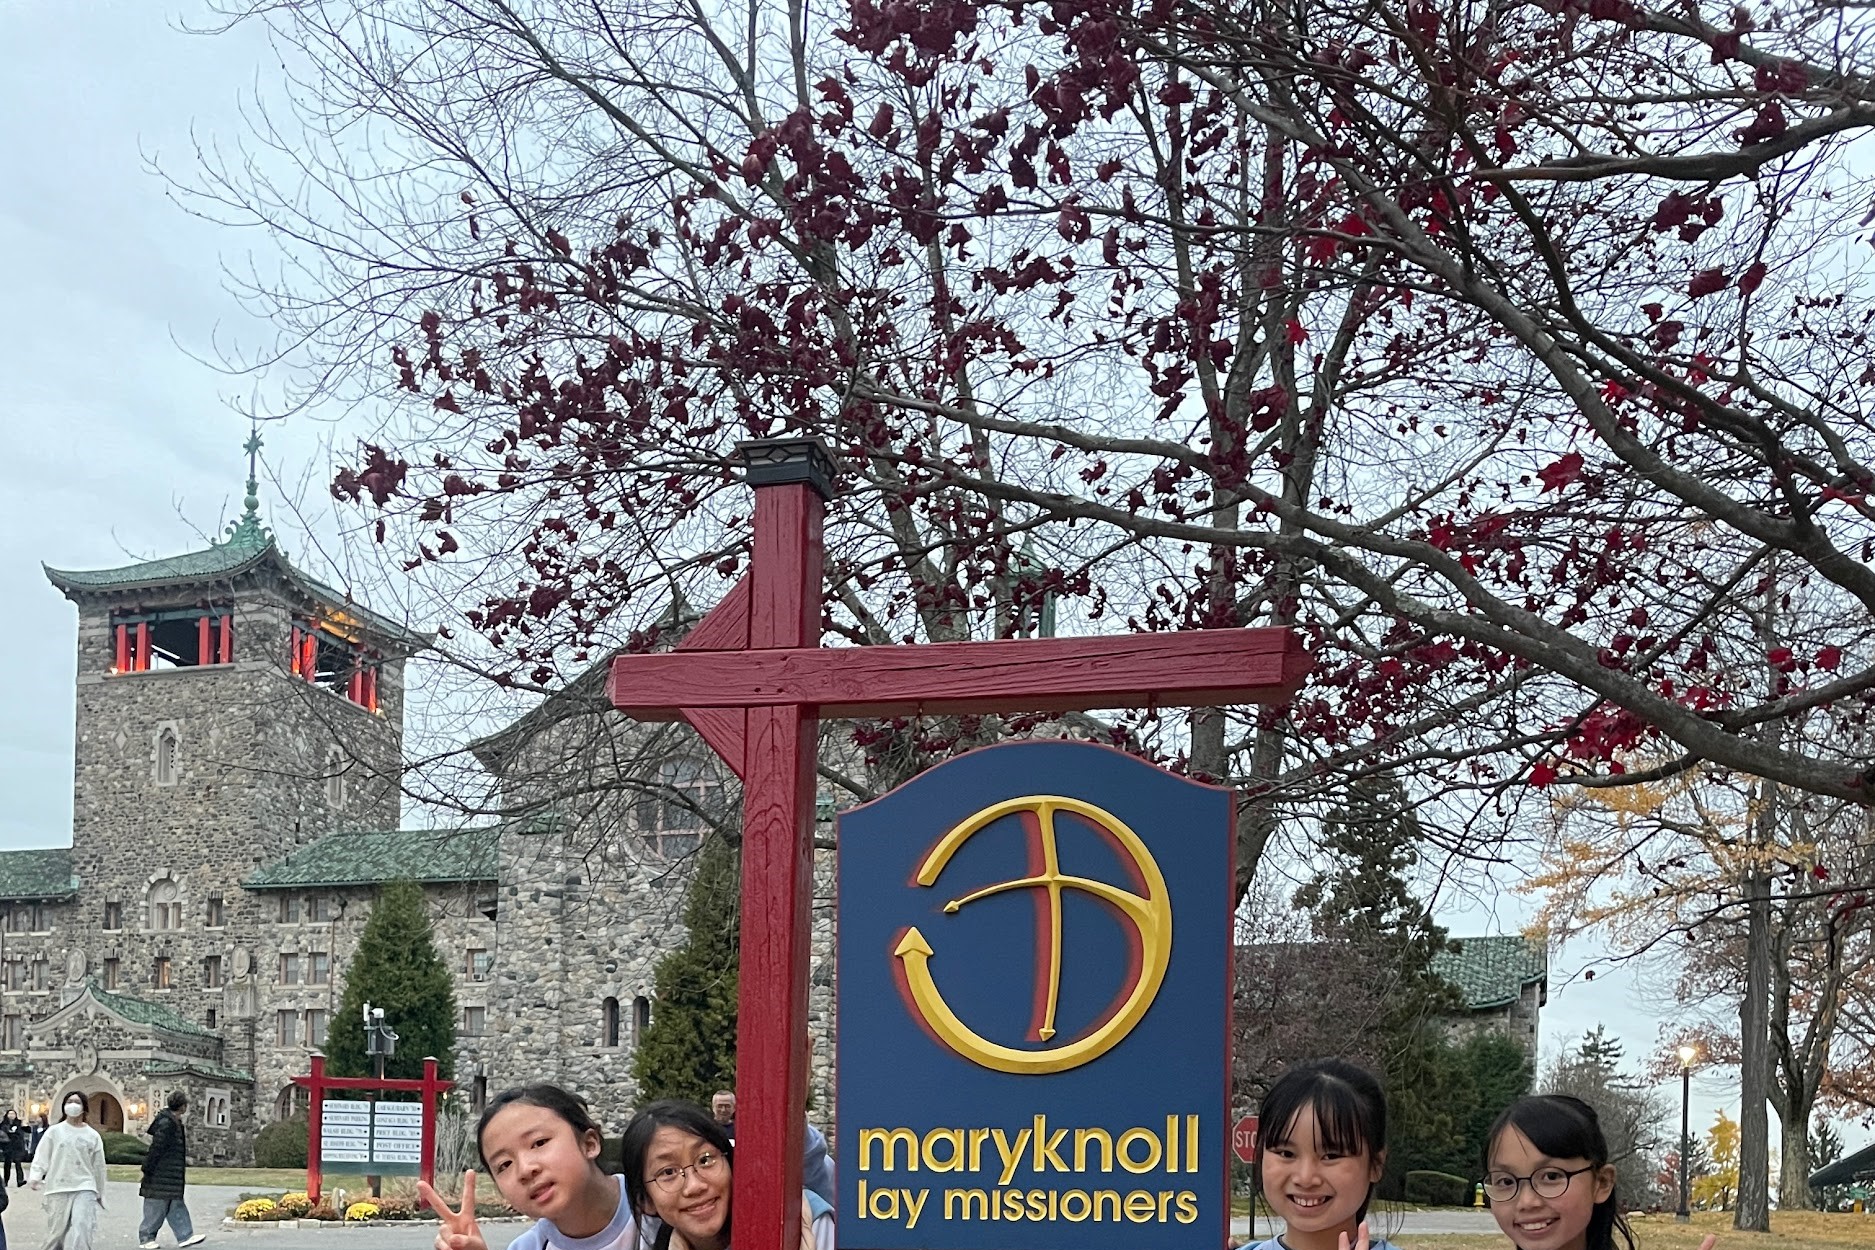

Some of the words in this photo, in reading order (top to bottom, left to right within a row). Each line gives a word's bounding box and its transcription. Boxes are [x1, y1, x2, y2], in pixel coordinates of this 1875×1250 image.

[858, 1114, 1199, 1185] maryknoll
[1235, 1130, 1257, 1149] STO
[858, 1179, 929, 1229] lay
[944, 1189, 1198, 1224] missioners
